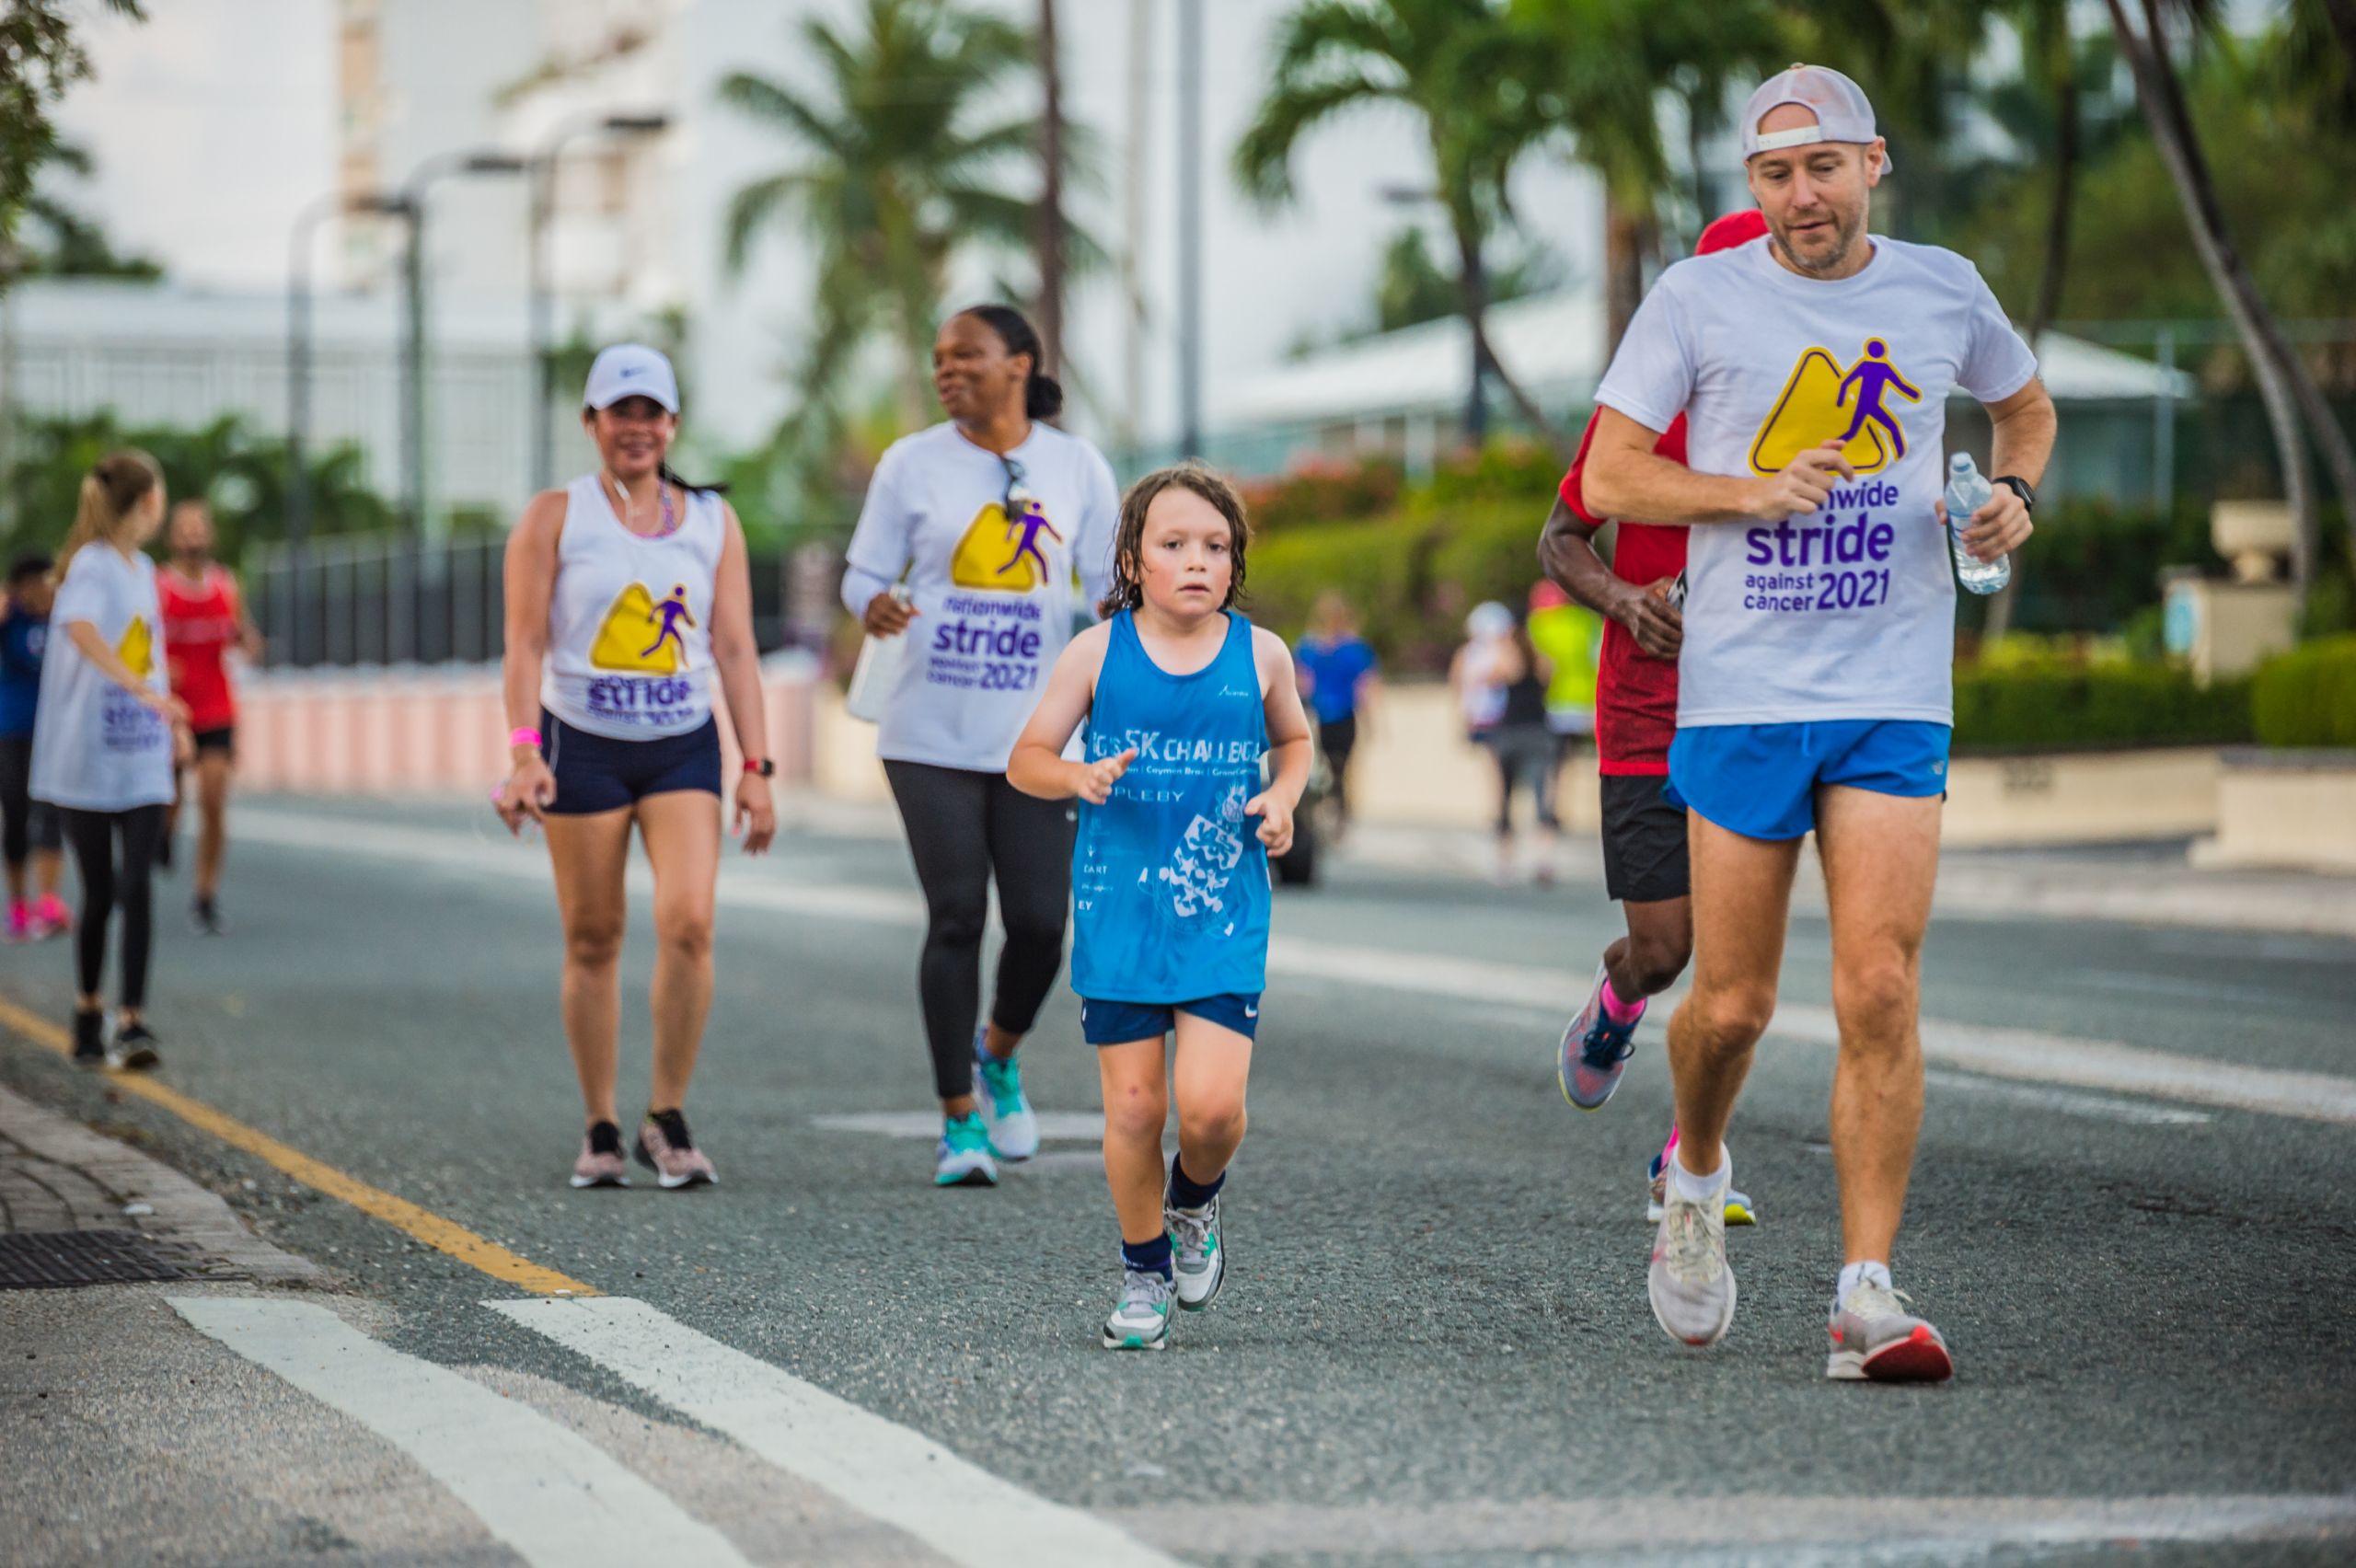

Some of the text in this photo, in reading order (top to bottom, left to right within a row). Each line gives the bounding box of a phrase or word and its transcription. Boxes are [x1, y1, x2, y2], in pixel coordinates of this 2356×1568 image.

[1746, 512, 1894, 567] stride
[1745, 573, 1814, 593] against
[1817, 568, 1889, 610] 2021
[1744, 594, 1815, 611] cancer
[933, 618, 1041, 658] stride
[980, 663, 1038, 689] 2021
[1126, 729, 1160, 760] 5K
